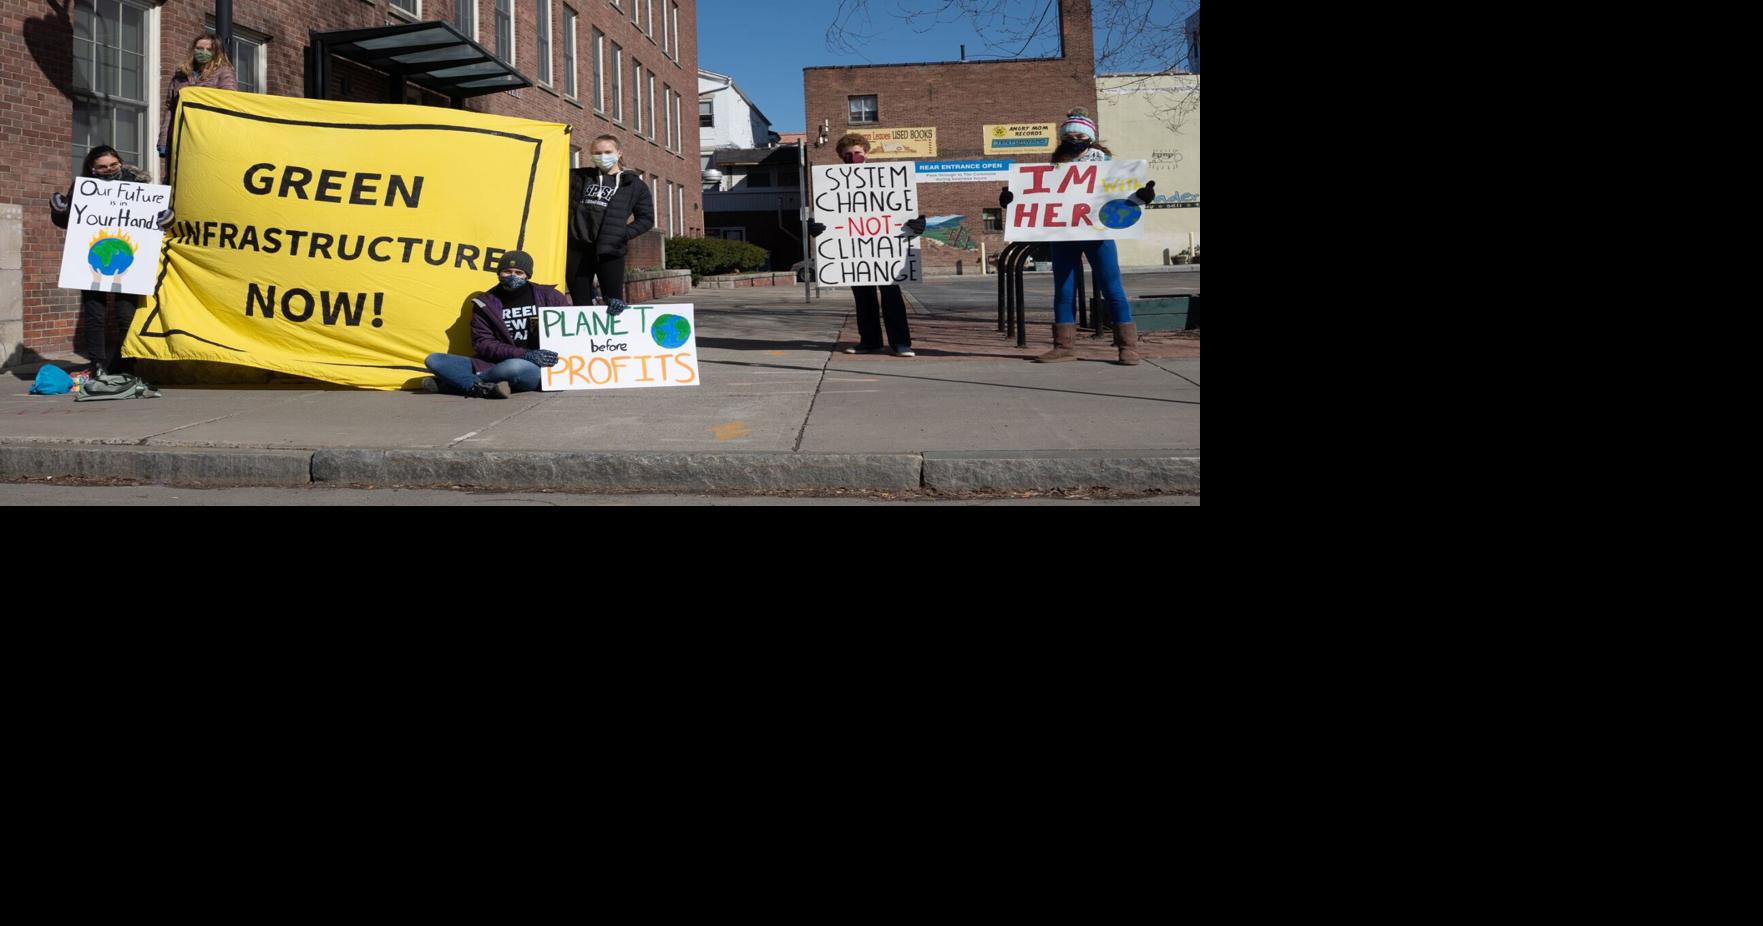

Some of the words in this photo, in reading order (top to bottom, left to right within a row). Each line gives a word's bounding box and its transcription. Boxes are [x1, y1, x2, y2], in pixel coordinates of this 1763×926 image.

[892, 129, 909, 140] USED
[910, 129, 933, 140] BOOKS
[243, 162, 425, 209] GREEN
[825, 165, 908, 191] SYSTEM
[80, 179, 113, 197] Our
[117, 182, 165, 204] Future
[815, 189, 914, 213] CHANGE
[74, 203, 118, 226] Your
[1013, 202, 1094, 228] HER
[177, 220, 506, 273] INFRASTRUCTURE
[818, 236, 916, 260] CLIMATE
[819, 260, 917, 285] CHANGE
[245, 282, 385, 329] NOW!
[502, 304, 537, 319] REE
[504, 318, 527, 331] EW
[542, 306, 654, 338] PLANET
[590, 338, 628, 353] before
[548, 352, 696, 386] PROFITS
